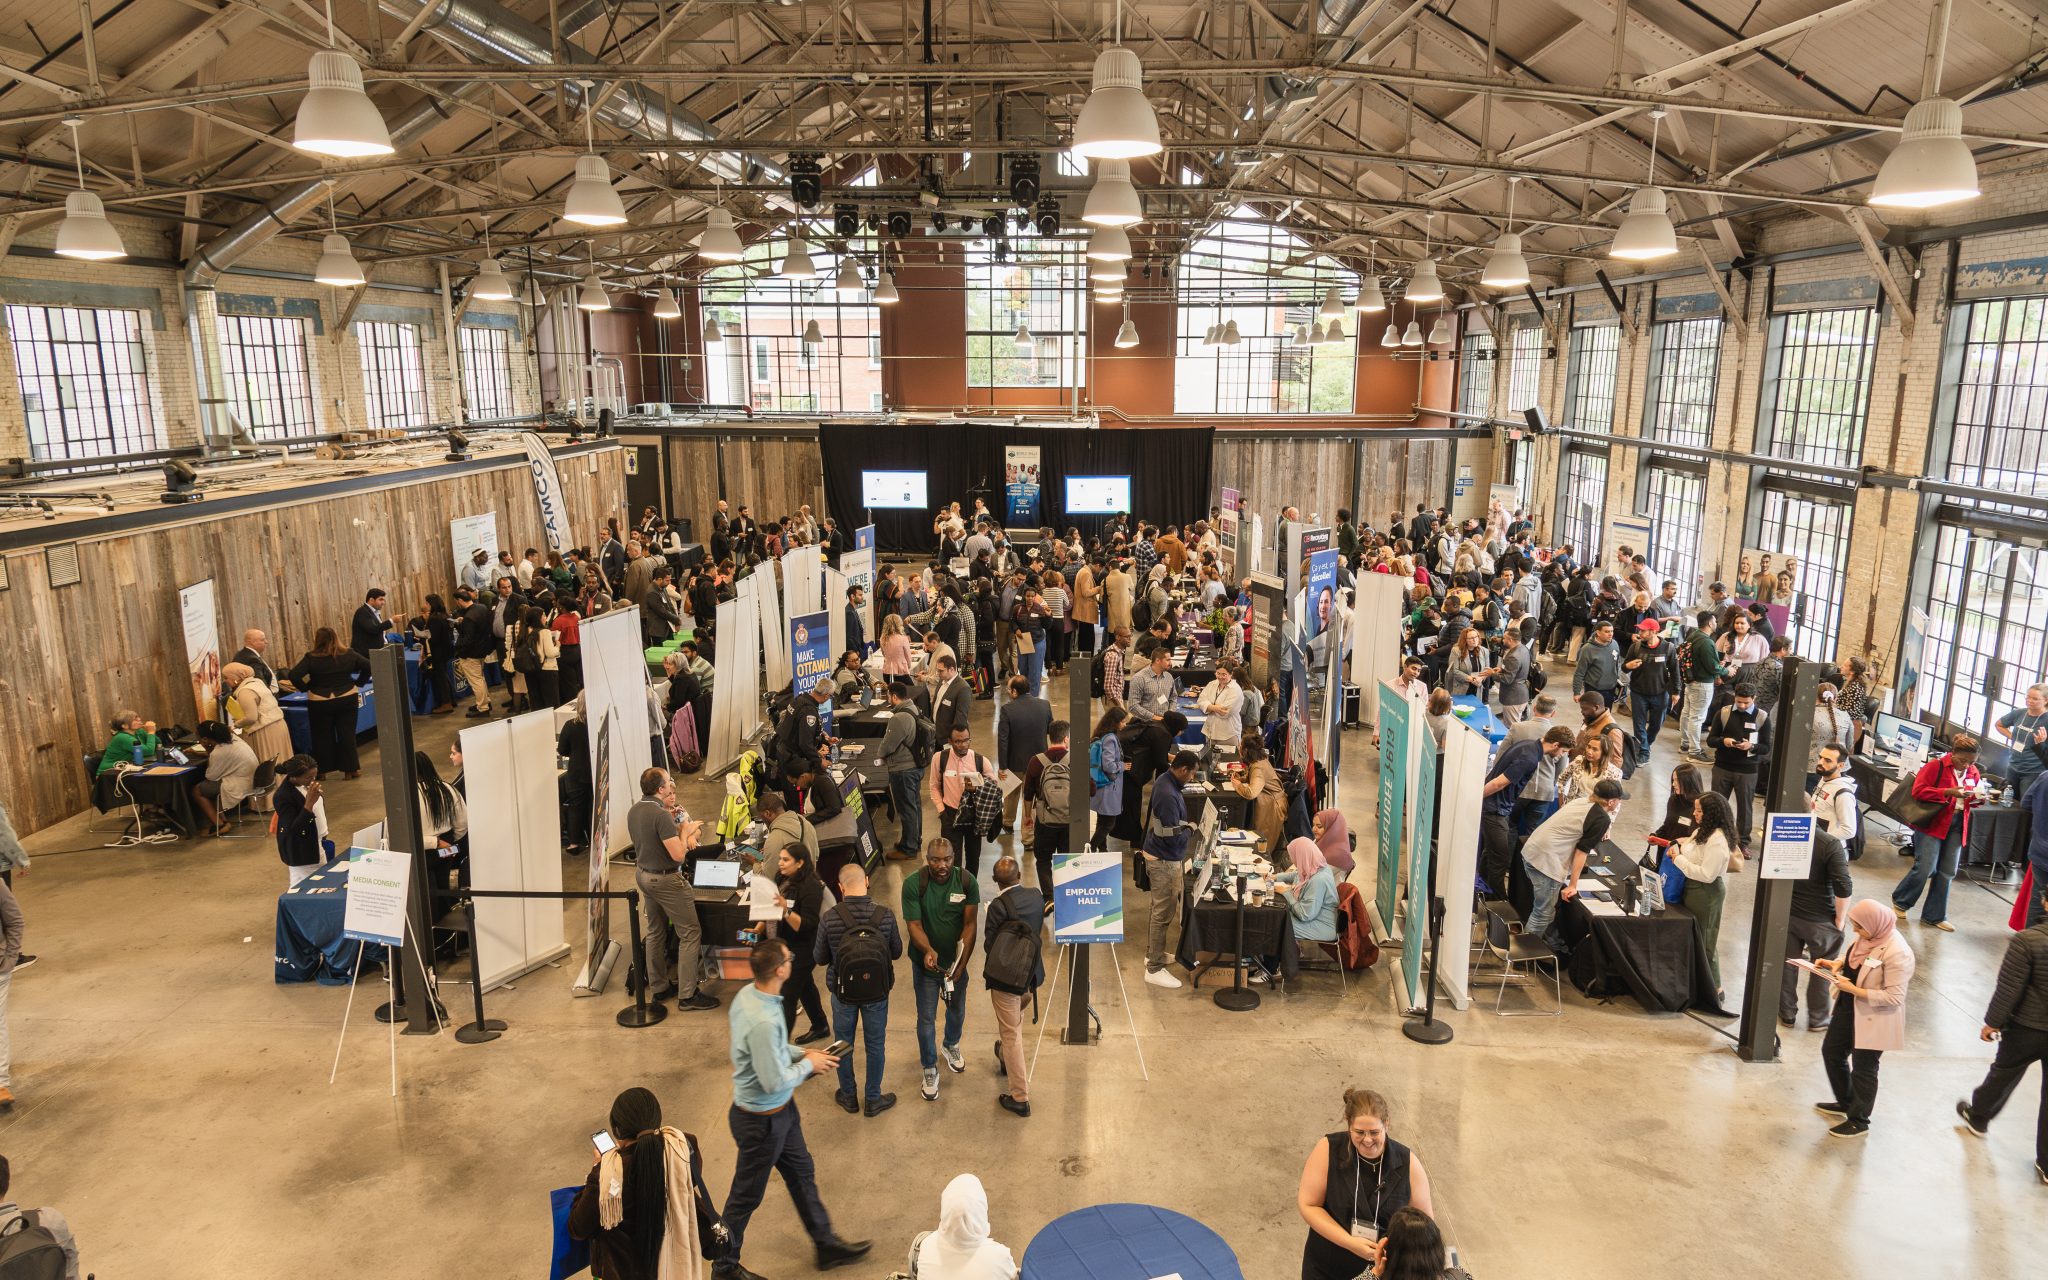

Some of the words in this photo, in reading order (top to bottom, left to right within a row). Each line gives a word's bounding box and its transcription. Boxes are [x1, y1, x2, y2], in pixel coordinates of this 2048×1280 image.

[532, 459, 561, 550] CAMCO
[847, 572, 868, 586] WE'RE
[1311, 571, 1332, 583] décolle!
[796, 649, 815, 664] MAKE
[797, 657, 830, 678] OTTAWA
[798, 676, 816, 690] YOUR
[1381, 775, 1393, 859] REFUGEE
[352, 876, 373, 885] MEDIA
[372, 878, 401, 889] CONSENT
[1065, 887, 1113, 896] EMPLOYER
[1077, 897, 1101, 905] HALL
